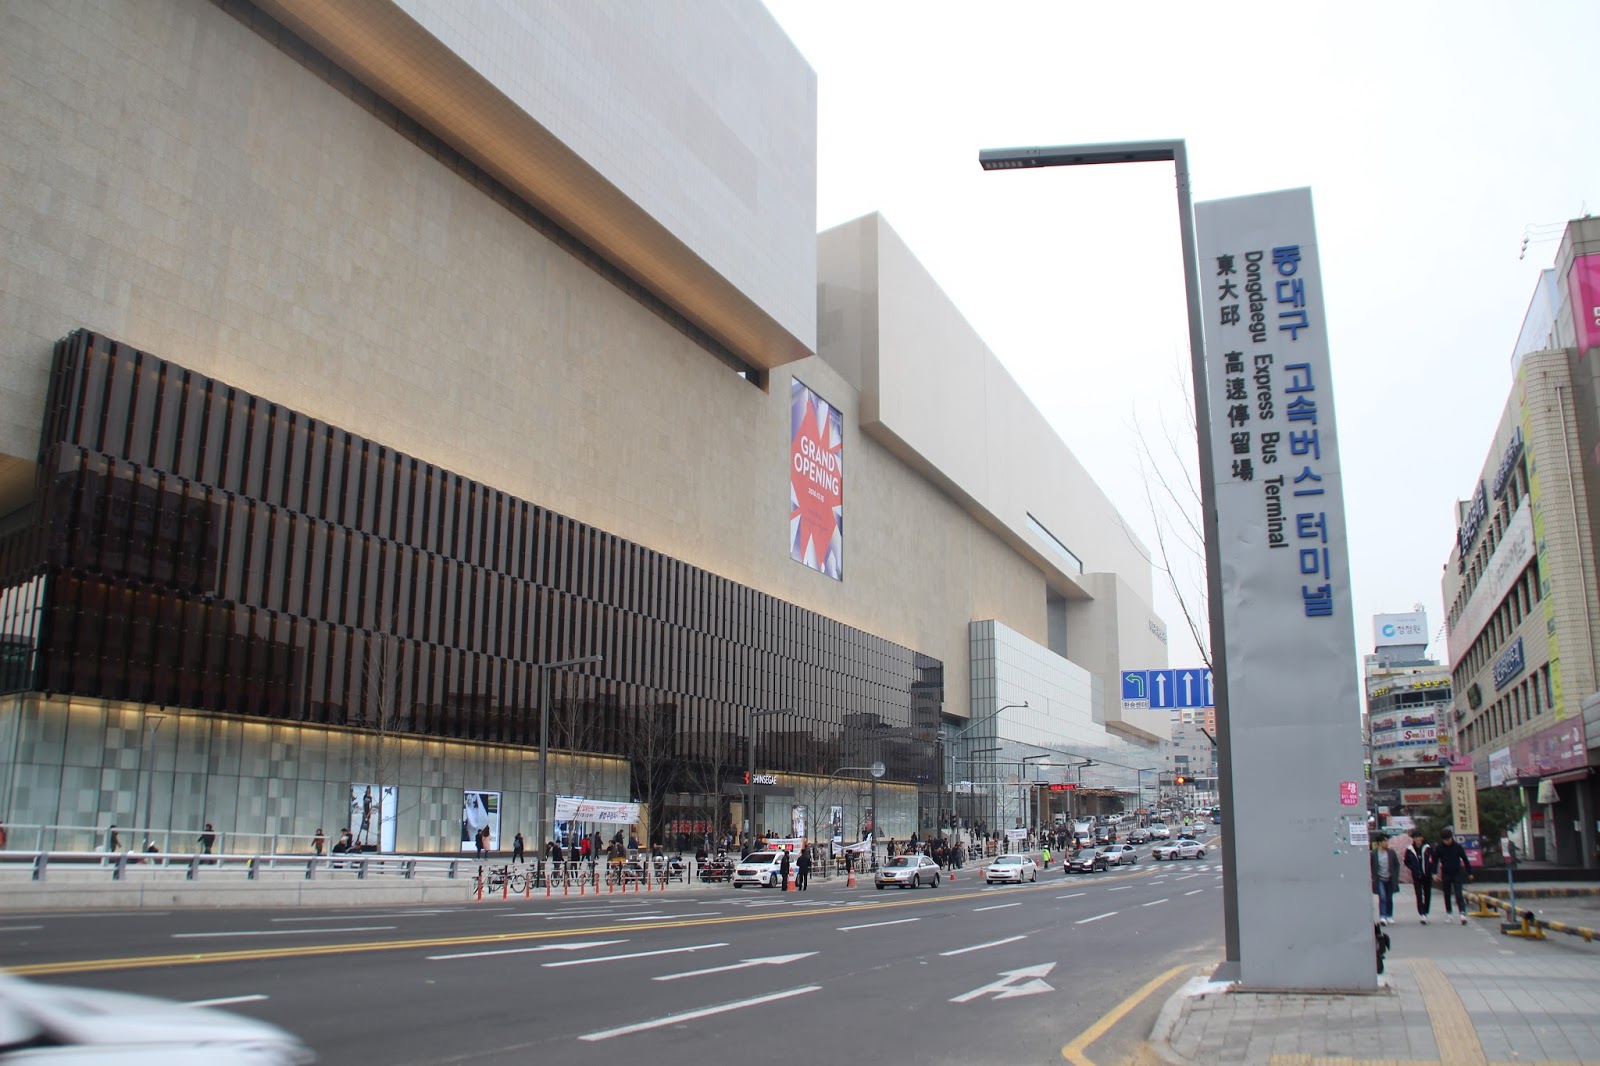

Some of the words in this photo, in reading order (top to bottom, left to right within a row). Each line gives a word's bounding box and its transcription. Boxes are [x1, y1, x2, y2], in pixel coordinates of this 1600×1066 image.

[1215, 254, 1241, 326] 東大邱
[1244, 251, 1268, 343] Dongdaegu
[1272, 245, 1309, 341] 동대구
[1253, 354, 1274, 420] Express
[794, 453, 839, 496] OPENING
[801, 435, 835, 472] GRAND
[1261, 432, 1280, 464] Bus
[1264, 474, 1289, 549] Terminal
[752, 774, 777, 785] SHINSEGAE
